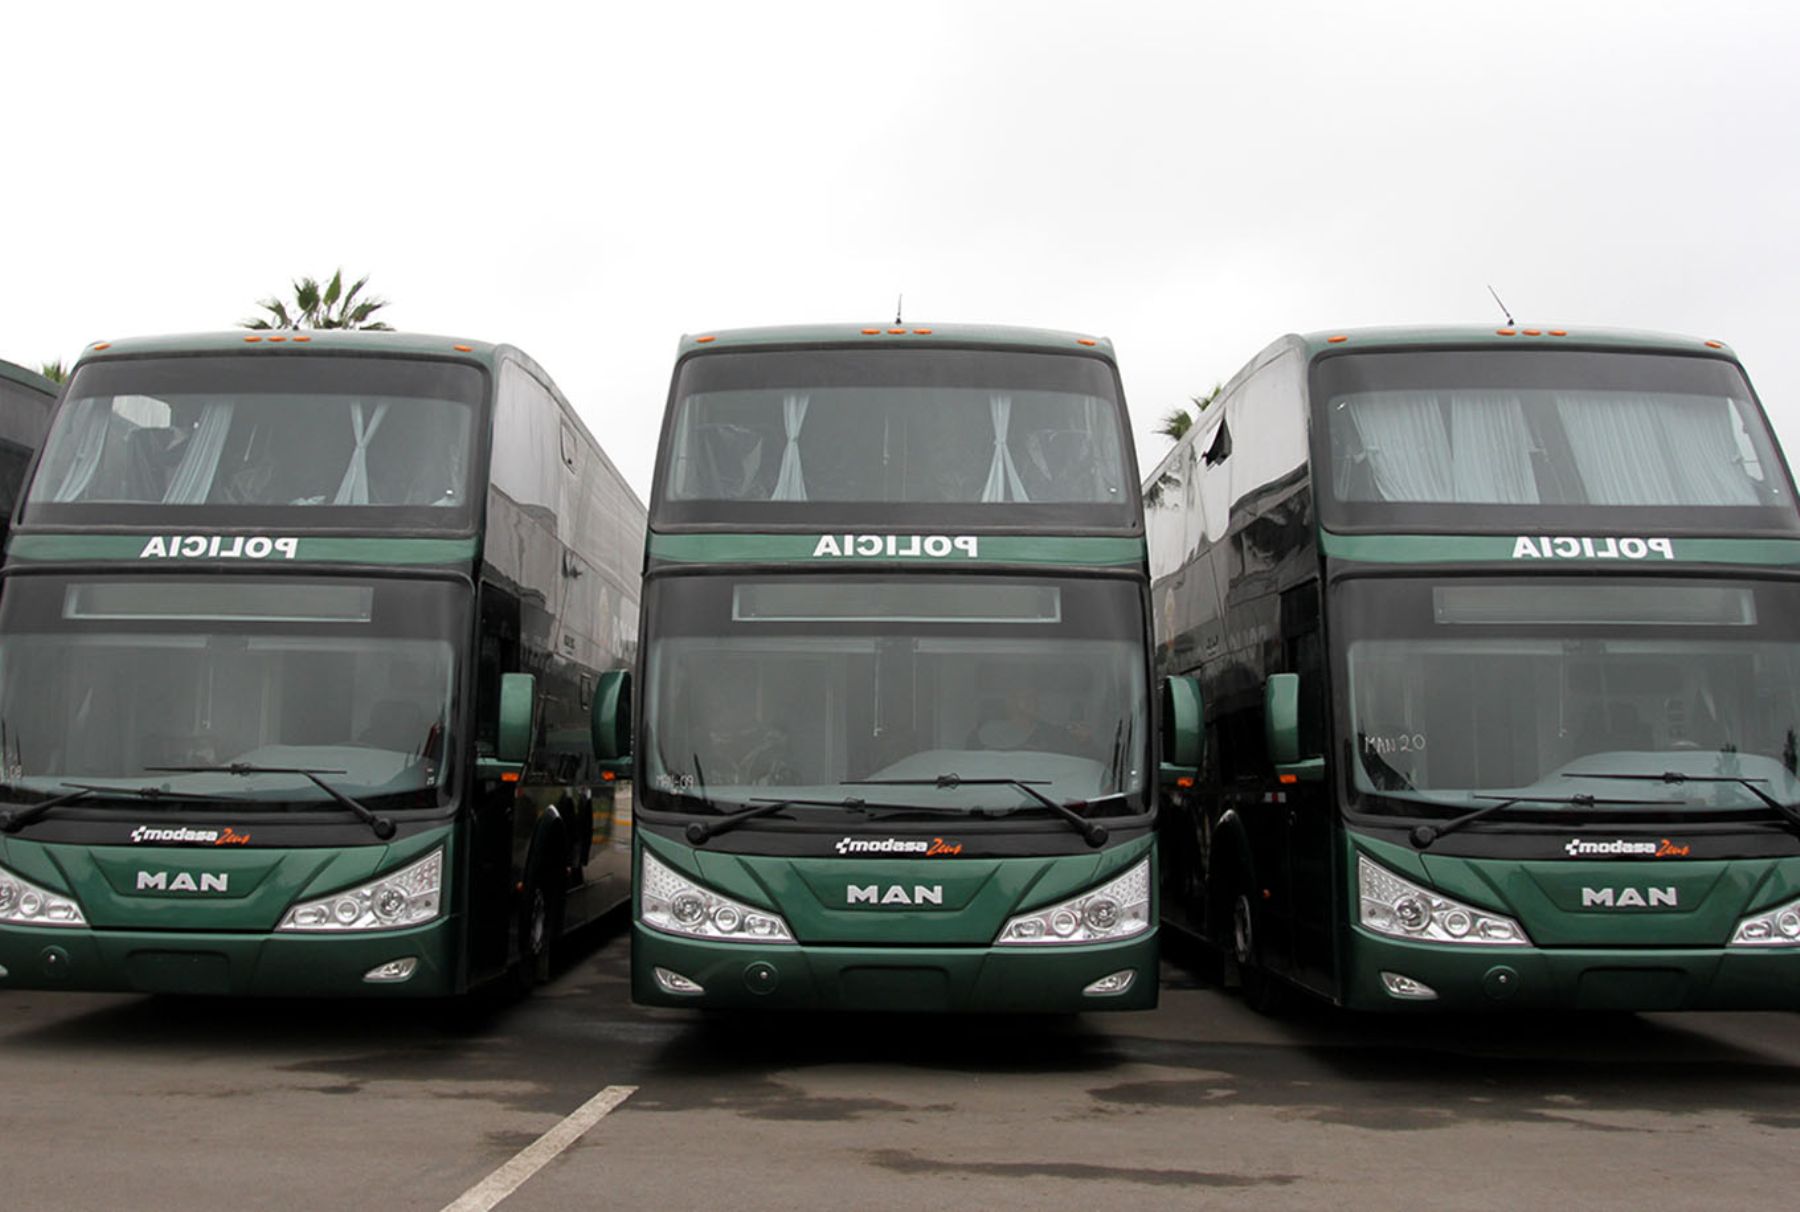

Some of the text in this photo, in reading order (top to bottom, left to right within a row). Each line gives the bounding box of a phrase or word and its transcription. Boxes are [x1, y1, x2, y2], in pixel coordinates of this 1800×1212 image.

[1399, 733, 1426, 752] 20
[143, 827, 218, 841] modasa
[848, 838, 928, 852] modasa
[1579, 840, 1656, 853] modasa
[137, 871, 228, 892] MAN
[847, 885, 943, 904] MAN
[1582, 887, 1678, 907] MAN
